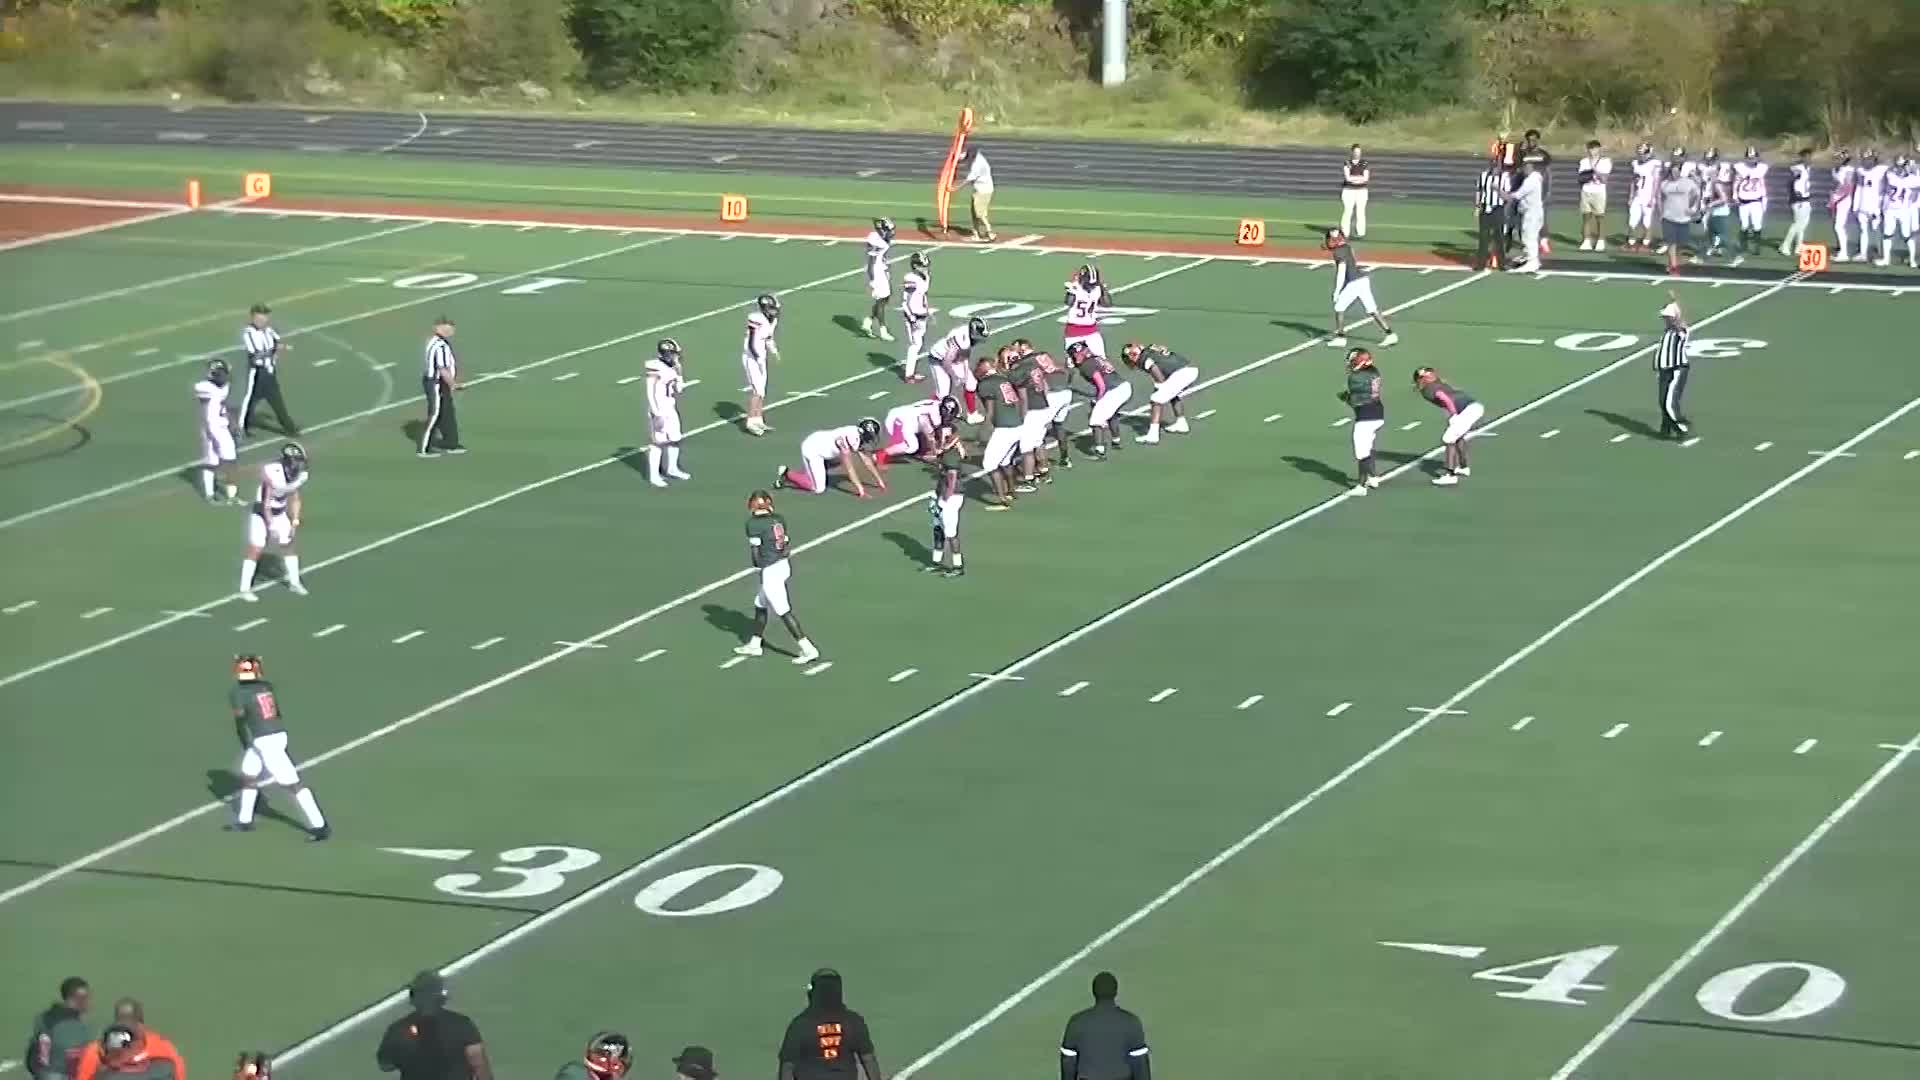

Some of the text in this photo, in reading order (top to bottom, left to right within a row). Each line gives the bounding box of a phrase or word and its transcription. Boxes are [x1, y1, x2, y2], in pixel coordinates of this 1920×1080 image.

[253, 177, 264, 194] G
[727, 200, 742, 217] 10
[1242, 223, 1260, 241] 20
[1803, 249, 1822, 266] 30
[1076, 300, 1096, 318] 54
